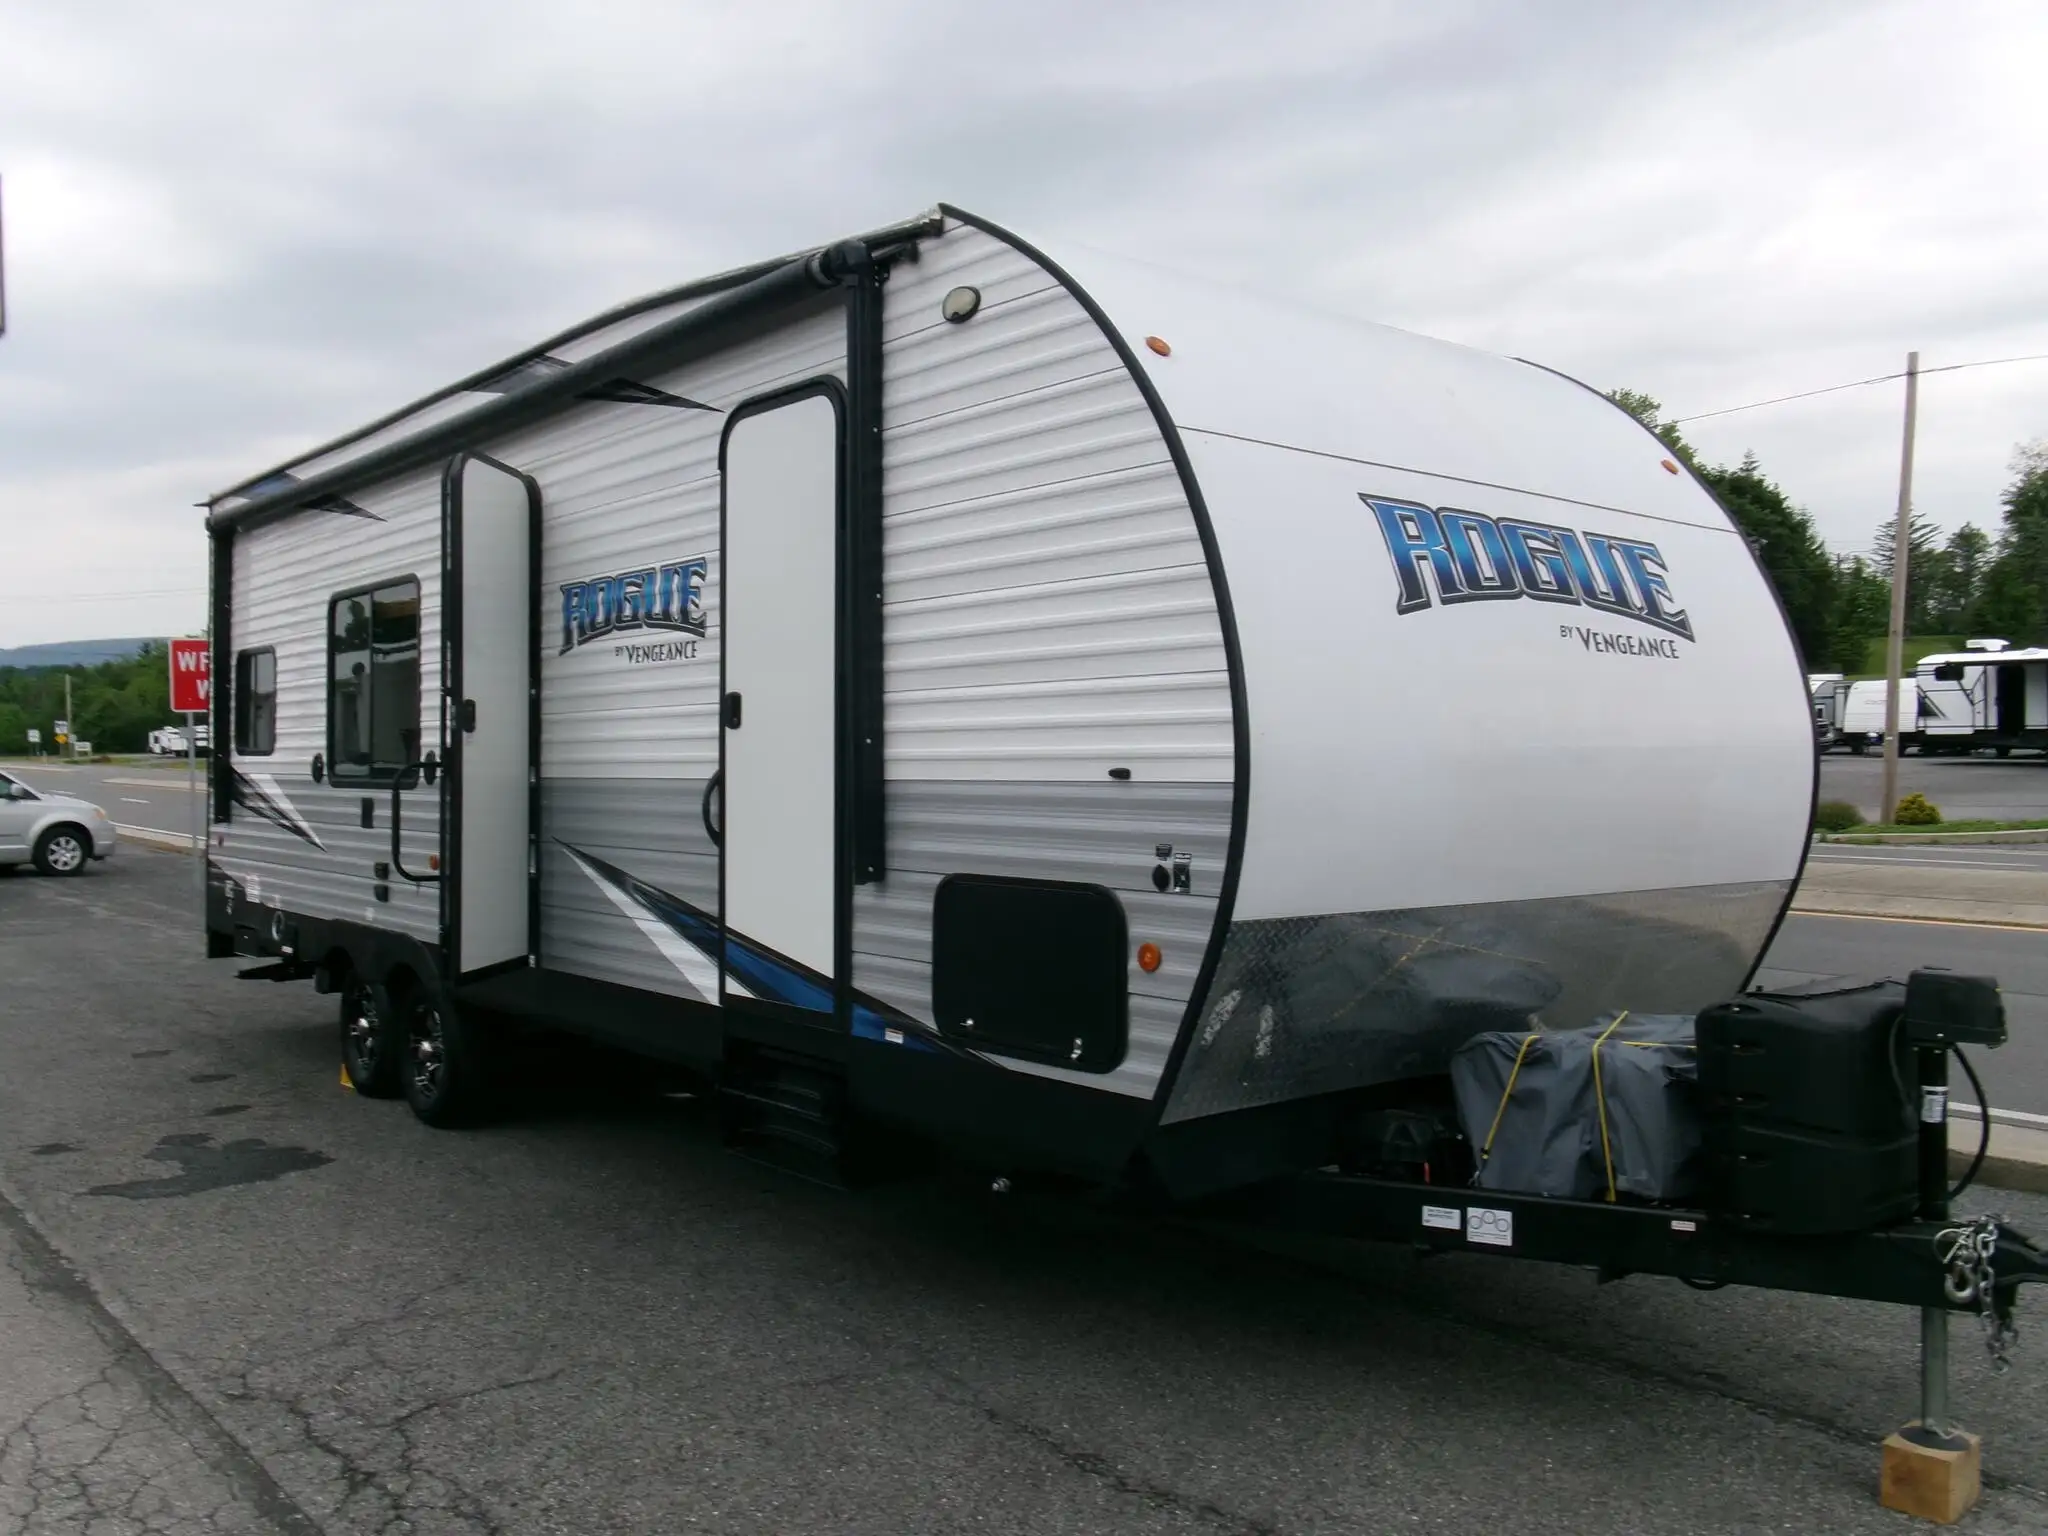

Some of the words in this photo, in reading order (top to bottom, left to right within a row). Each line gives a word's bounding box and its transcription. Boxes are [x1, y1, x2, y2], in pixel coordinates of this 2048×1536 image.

[1357, 492, 1696, 643] ROGUE
[558, 556, 708, 657] ROGUE
[626, 640, 697, 664] VENGEANCE
[1559, 625, 1574, 639] BY
[1576, 626, 1680, 659] VENGEANCE
